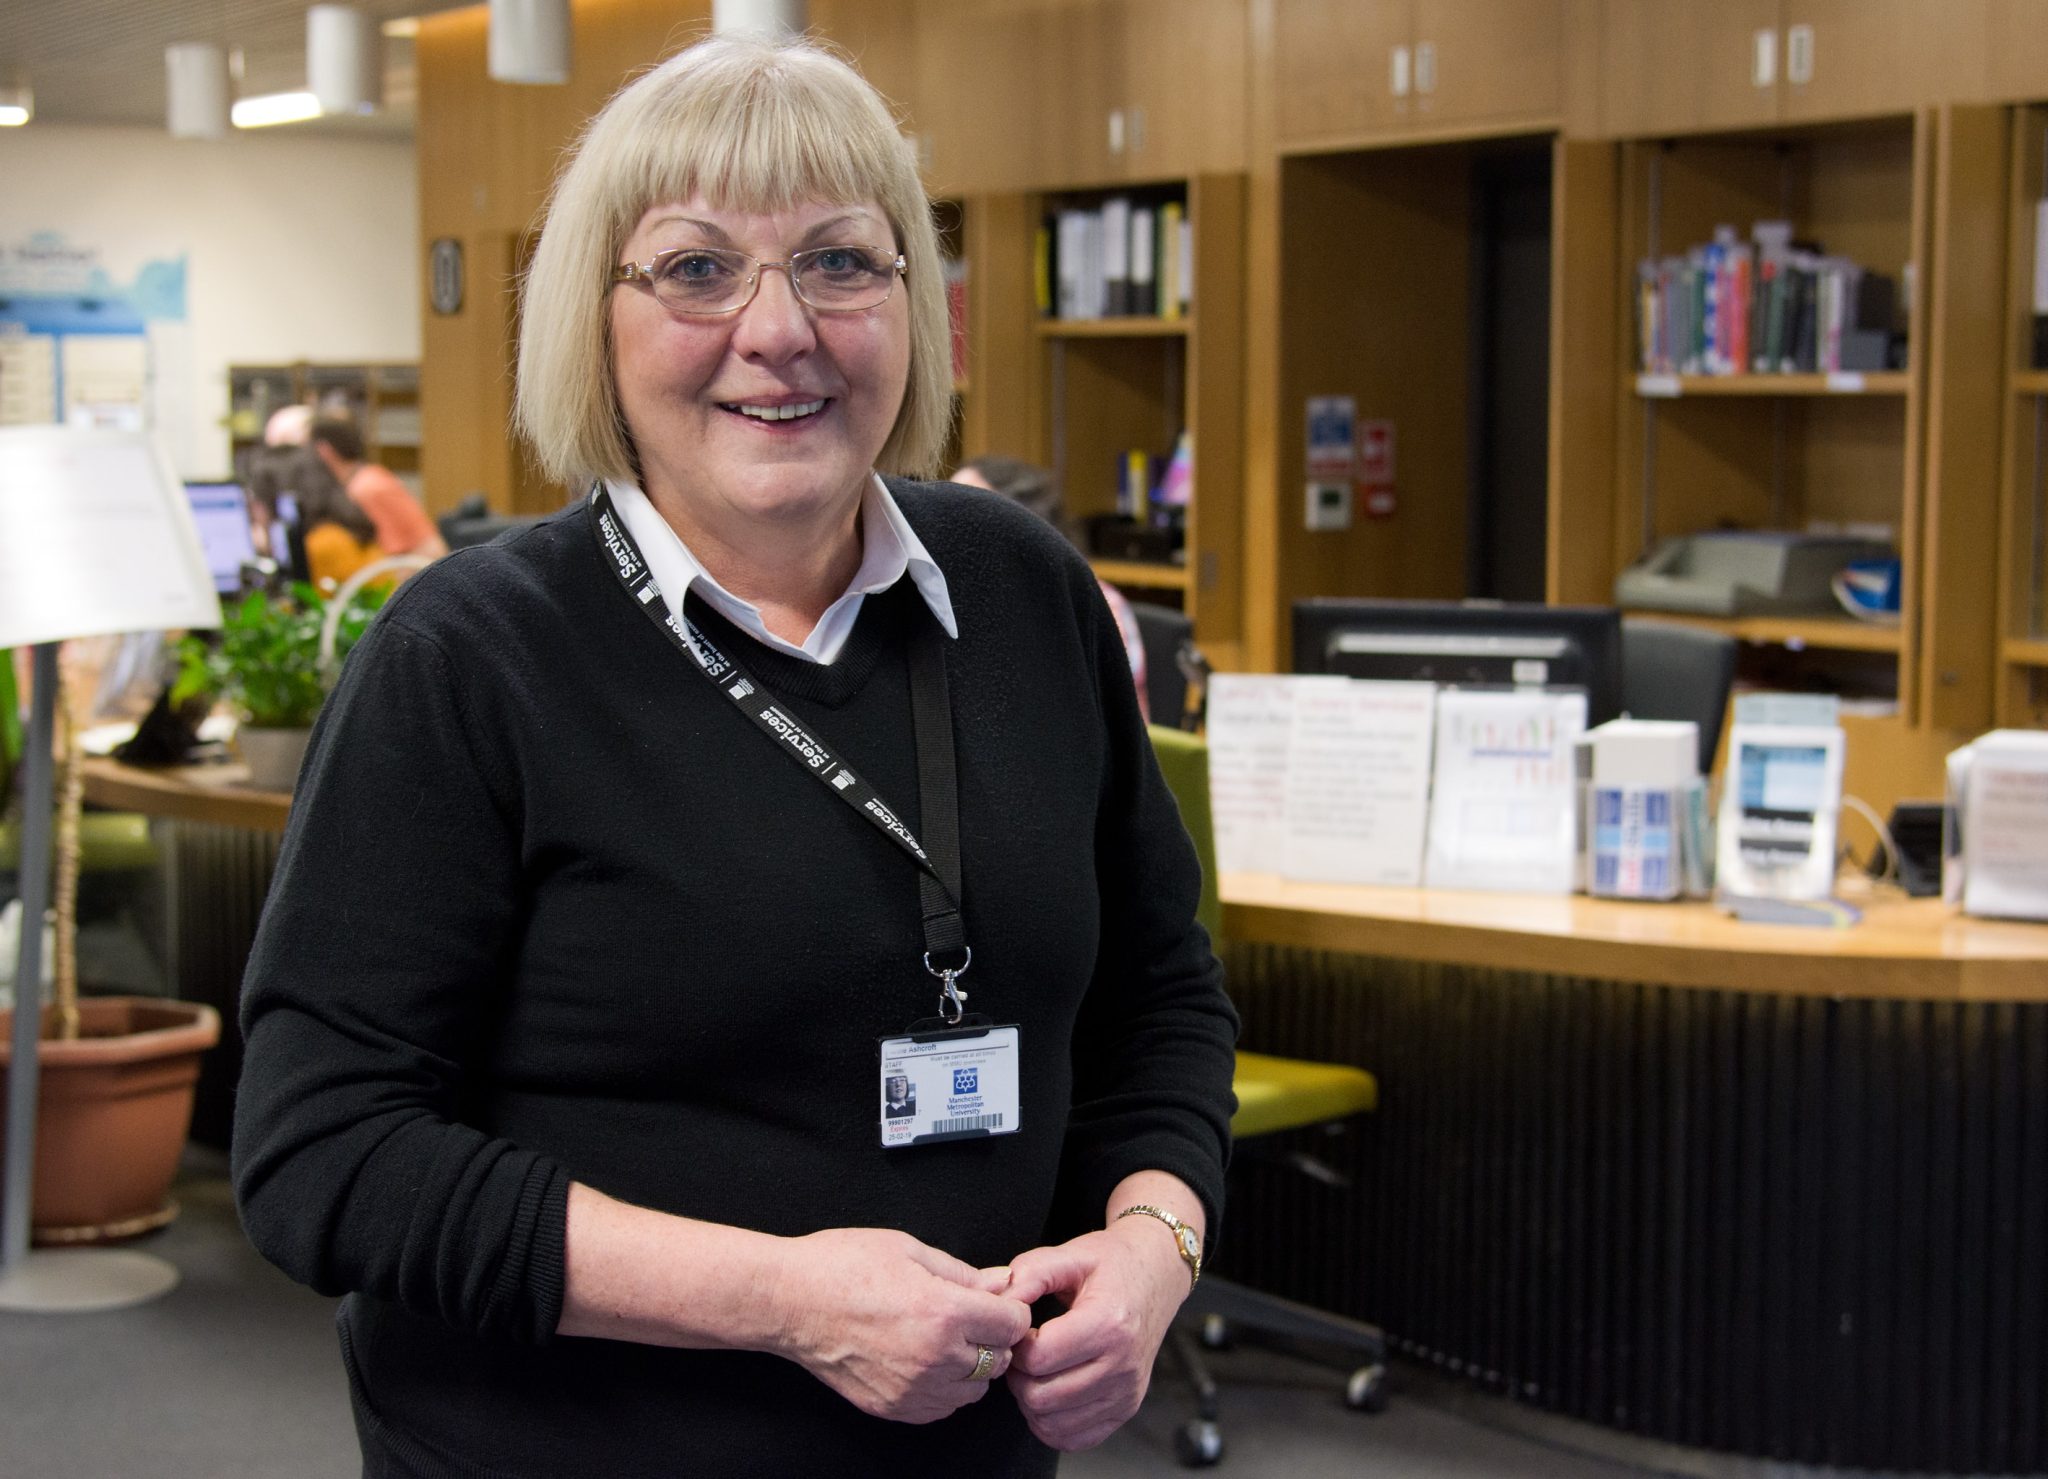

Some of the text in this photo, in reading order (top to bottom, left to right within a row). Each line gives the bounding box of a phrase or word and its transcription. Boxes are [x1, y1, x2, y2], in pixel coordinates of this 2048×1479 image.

[599, 513, 637, 579] Services
[702, 639, 718, 654] heart
[759, 709, 825, 768] Services
[864, 800, 927, 859] Services
[908, 1043, 937, 1053] Ashcroft
[949, 1095, 983, 1104] Manchester
[947, 1101, 984, 1112] Metropolitan
[950, 1108, 981, 1117] University
